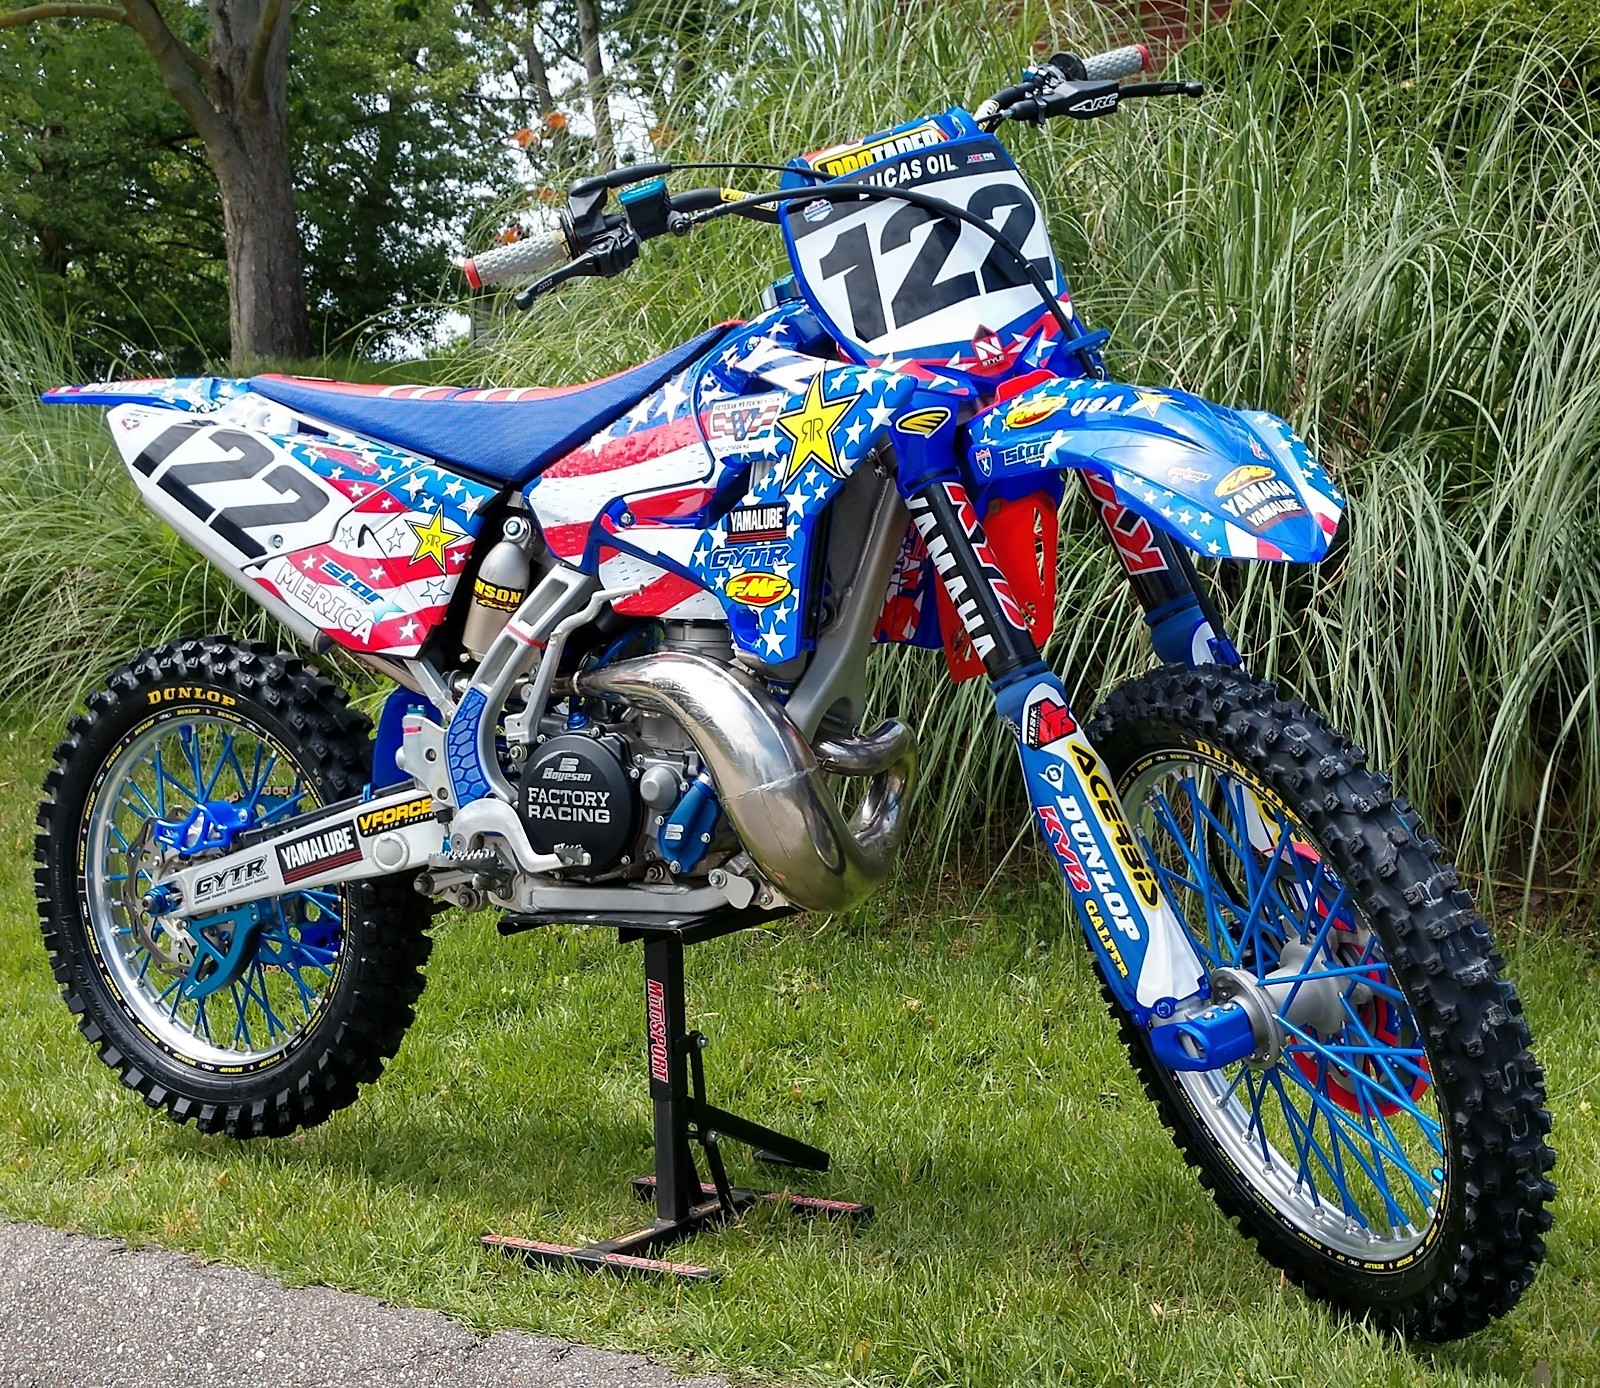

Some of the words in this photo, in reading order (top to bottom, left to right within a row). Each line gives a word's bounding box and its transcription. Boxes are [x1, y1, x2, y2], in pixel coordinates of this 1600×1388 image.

[1069, 93, 1119, 112] ARC
[926, 153, 957, 174] OIL
[819, 183, 1053, 344] 122
[982, 356, 1004, 367] STYLE
[1070, 396, 1123, 417] USA
[133, 423, 330, 559] 122
[1220, 480, 1296, 518] YAMAHA
[730, 507, 784, 532] YAMALUBE
[1247, 498, 1302, 527] YAMALUBE
[710, 544, 792, 570] GYTR
[322, 562, 385, 605] star
[726, 578, 788, 598] FMF
[275, 561, 375, 645] MERICA
[147, 687, 236, 707] DUNLOP
[177, 708, 200, 716] DUNLOP
[217, 711, 242, 723] DUNLOP
[134, 719, 155, 736] DUNLOP
[1028, 707, 1038, 745] TUSK
[106, 745, 123, 769] DUNLOP
[271, 740, 293, 763] DUNLOP
[542, 767, 592, 782] Boyesen
[1137, 758, 1153, 772] DUNLOP
[85, 791, 96, 820] DUNLOP
[527, 787, 610, 807] FACTORY
[359, 797, 432, 832] VFORCE
[527, 804, 611, 823] RACING
[378, 821, 400, 832] MOTO
[280, 827, 354, 870] YAMALUBE
[1037, 805, 1092, 893] KYB
[195, 856, 267, 899] GYTR
[1055, 795, 1141, 940] DUNLOP
[227, 881, 254, 893] TECHNOLOGY
[254, 876, 270, 884] RACING
[1085, 899, 1129, 979] GALFER
[647, 979, 669, 1083] MOTOSPORT
[172, 1052, 197, 1067] DUNLOP
[258, 1054, 281, 1068] DUNLOP
[1298, 1232, 1322, 1250] DUNLOP
